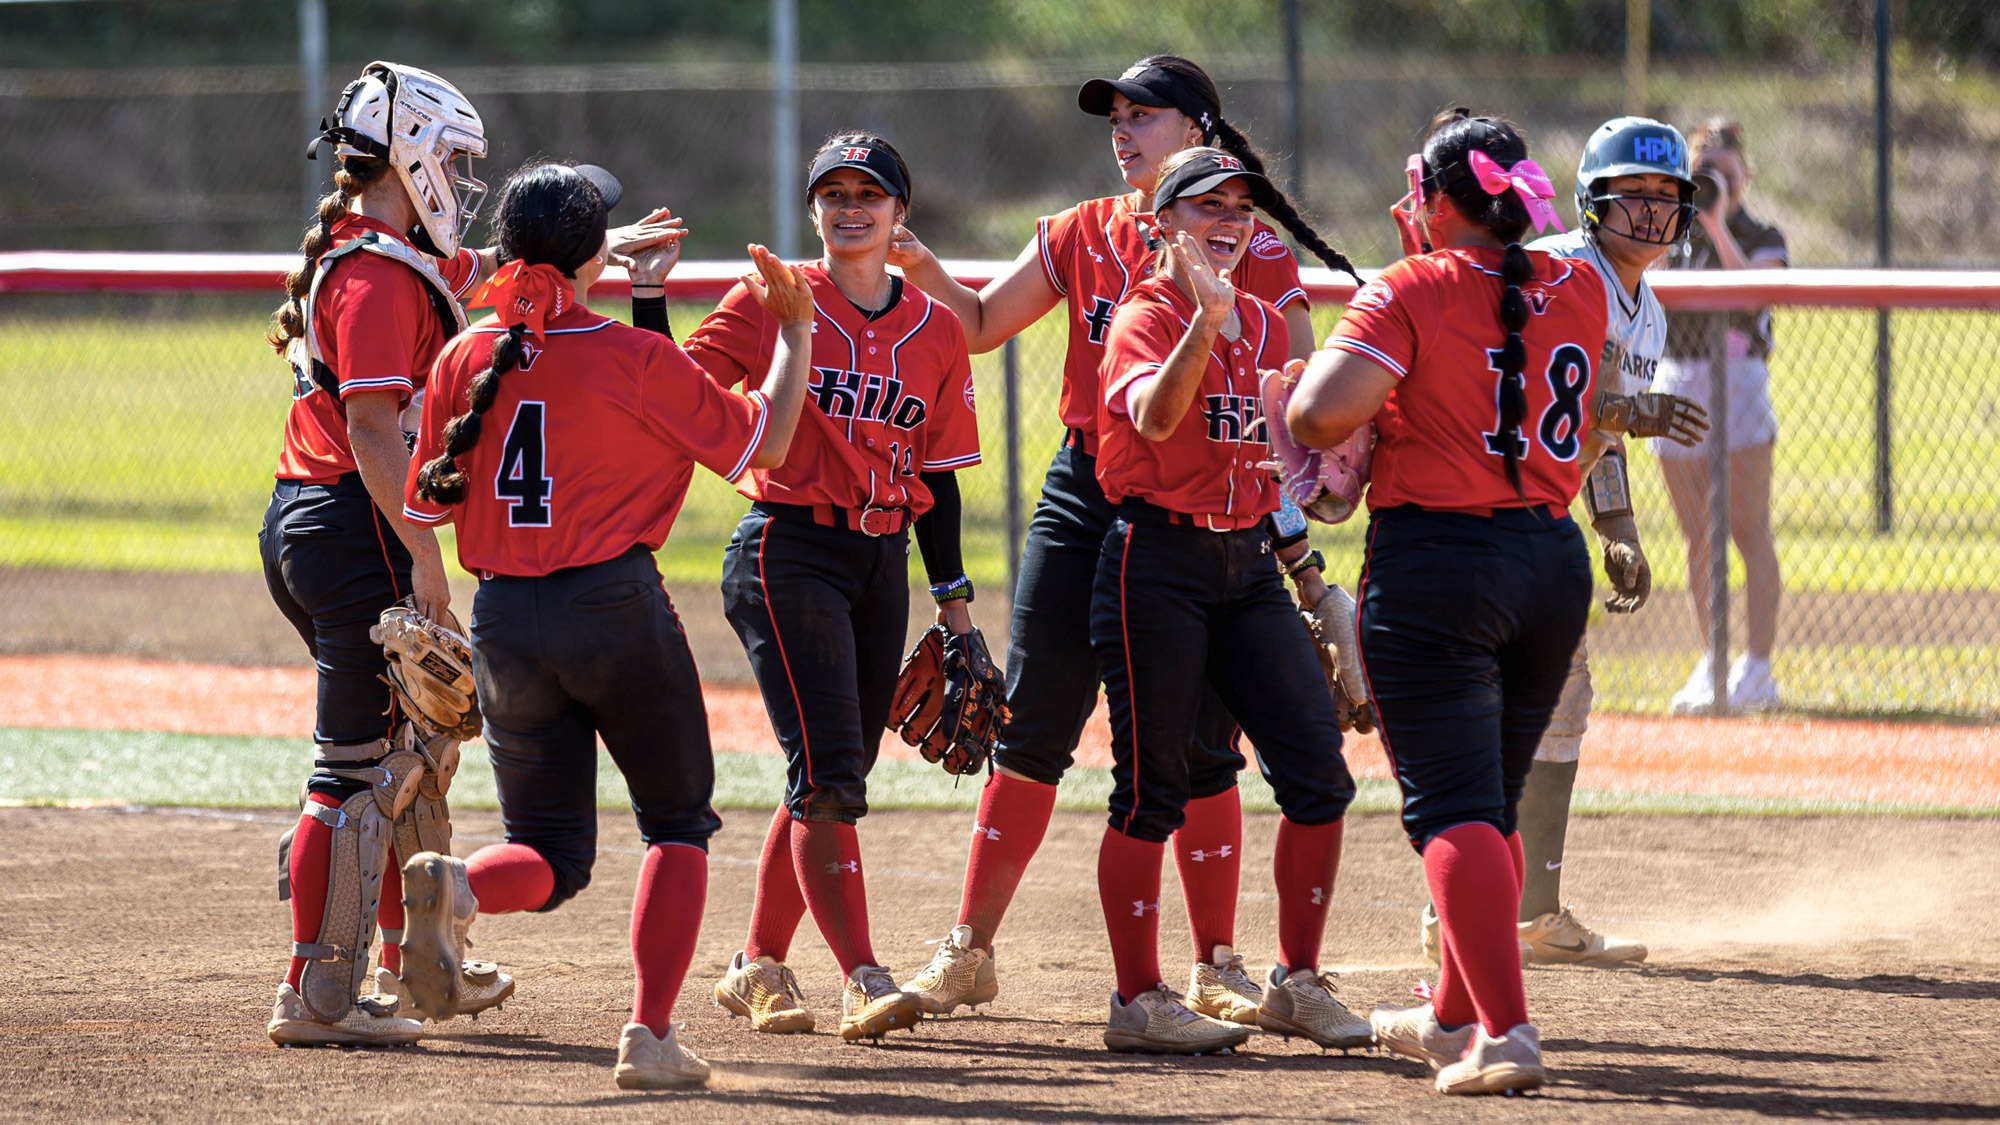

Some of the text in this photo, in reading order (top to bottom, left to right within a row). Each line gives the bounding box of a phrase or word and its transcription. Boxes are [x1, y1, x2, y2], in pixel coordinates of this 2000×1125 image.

[1634, 136, 1681, 167] HPU
[806, 365, 927, 432] Hilo
[1200, 393, 1270, 446] Hil
[1482, 342, 1592, 463] 18
[494, 400, 553, 528] 4
